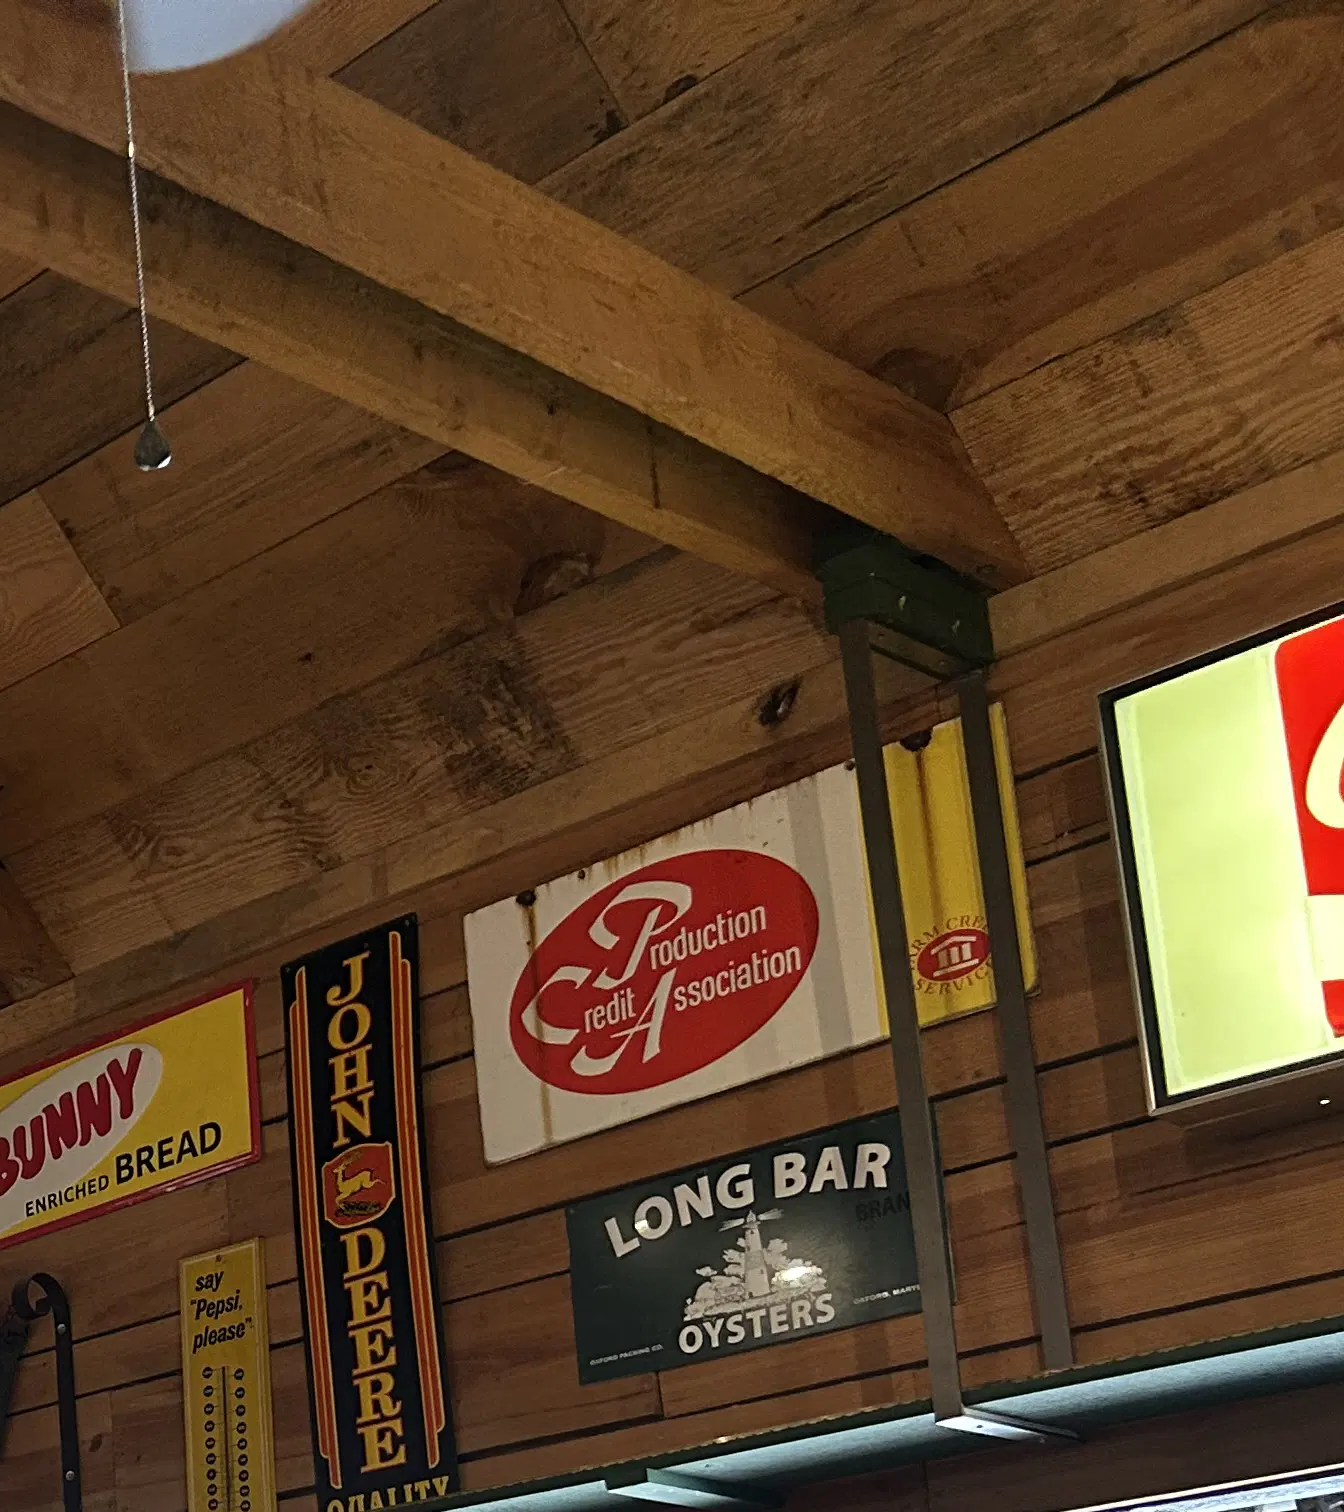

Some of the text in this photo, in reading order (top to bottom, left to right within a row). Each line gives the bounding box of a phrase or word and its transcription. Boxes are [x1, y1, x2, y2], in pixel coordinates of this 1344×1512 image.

[589, 881, 767, 989] Production
[946, 914, 989, 931] CRE
[522, 947, 801, 1077] Credit Association
[25, 1121, 223, 1217] ENRICHED BREAD
[326, 951, 406, 1472] JOHN DEERE
[604, 1142, 891, 1258] LONG BAR
[856, 1191, 910, 1222] BRAN
[194, 1270, 224, 1292] say
[677, 1293, 836, 1354] OYSTERS
